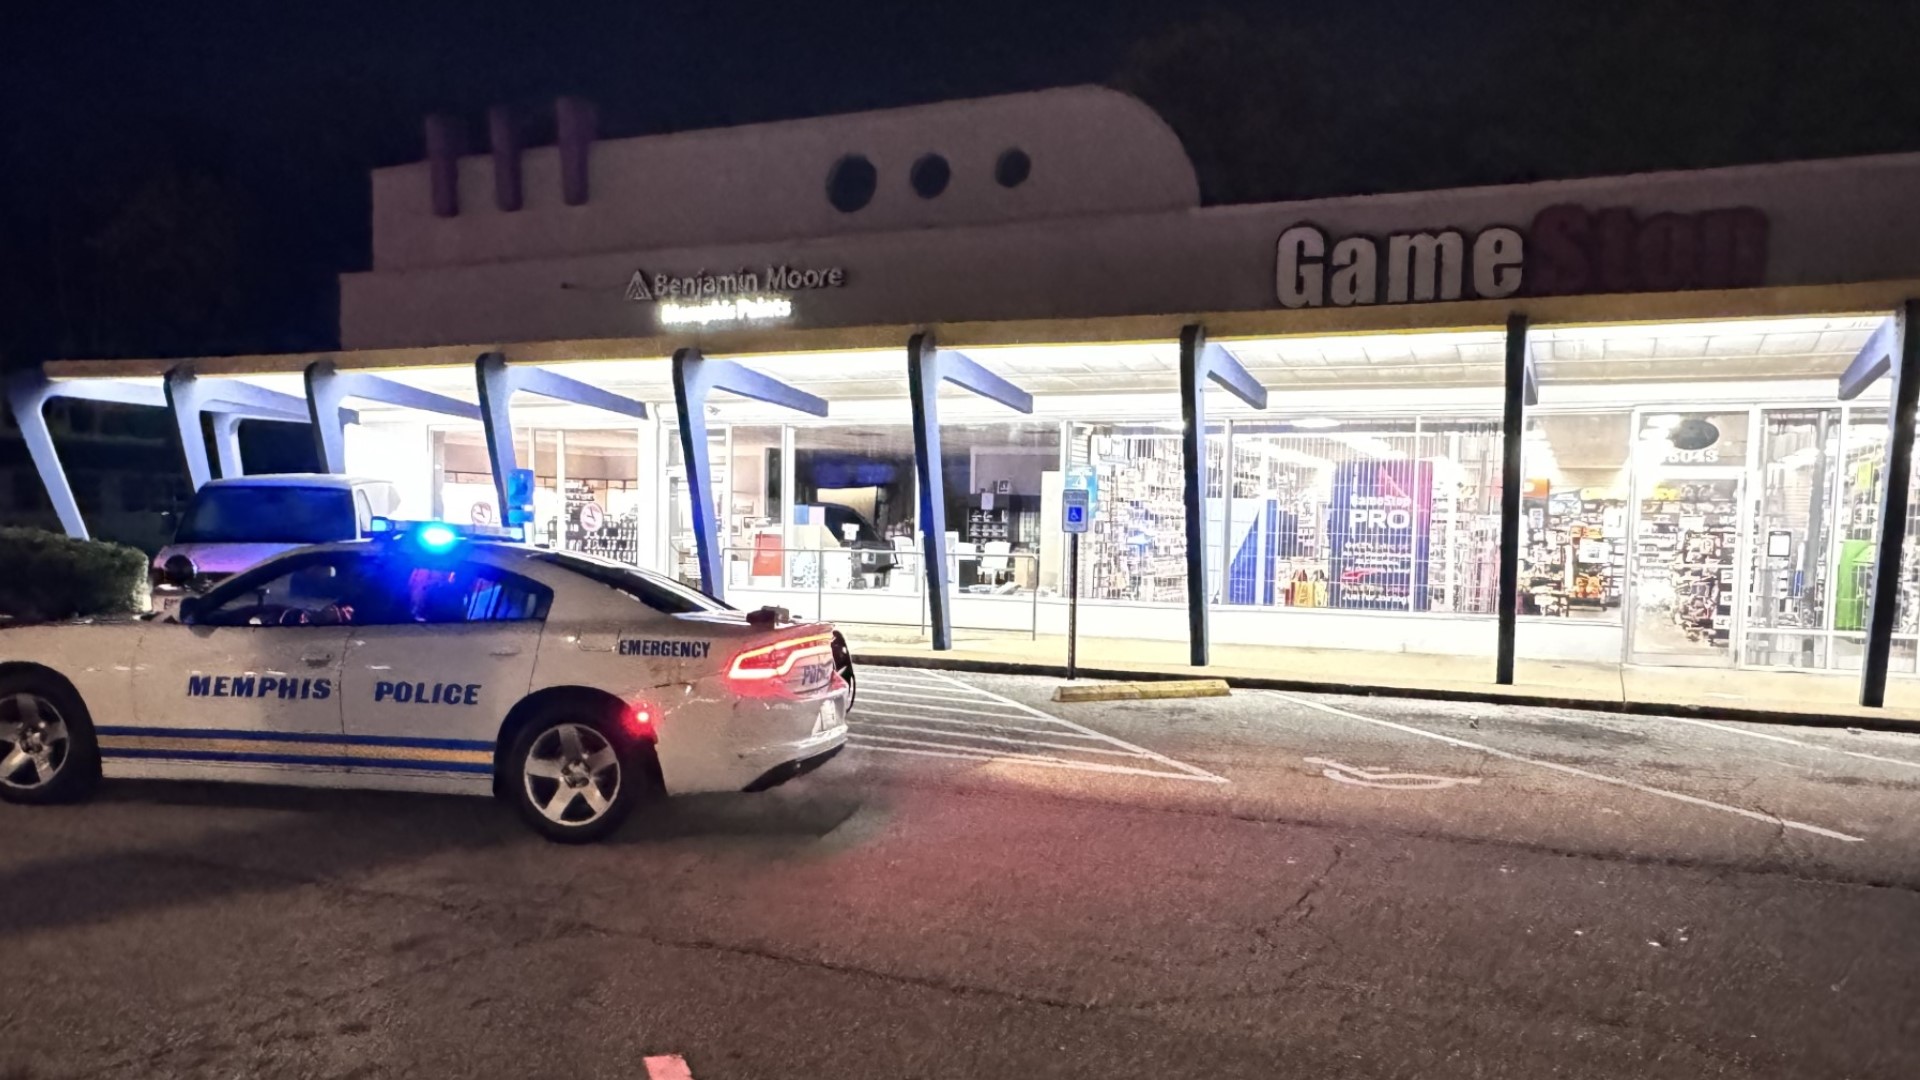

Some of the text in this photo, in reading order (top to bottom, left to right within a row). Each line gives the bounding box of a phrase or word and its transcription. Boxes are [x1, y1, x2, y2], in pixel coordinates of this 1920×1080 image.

[654, 264, 844, 298] Benjamin Moore
[1350, 509, 1410, 529] PRO
[619, 640, 711, 658] EMERGENCY
[187, 675, 482, 705] MEMPHIS POLICE
